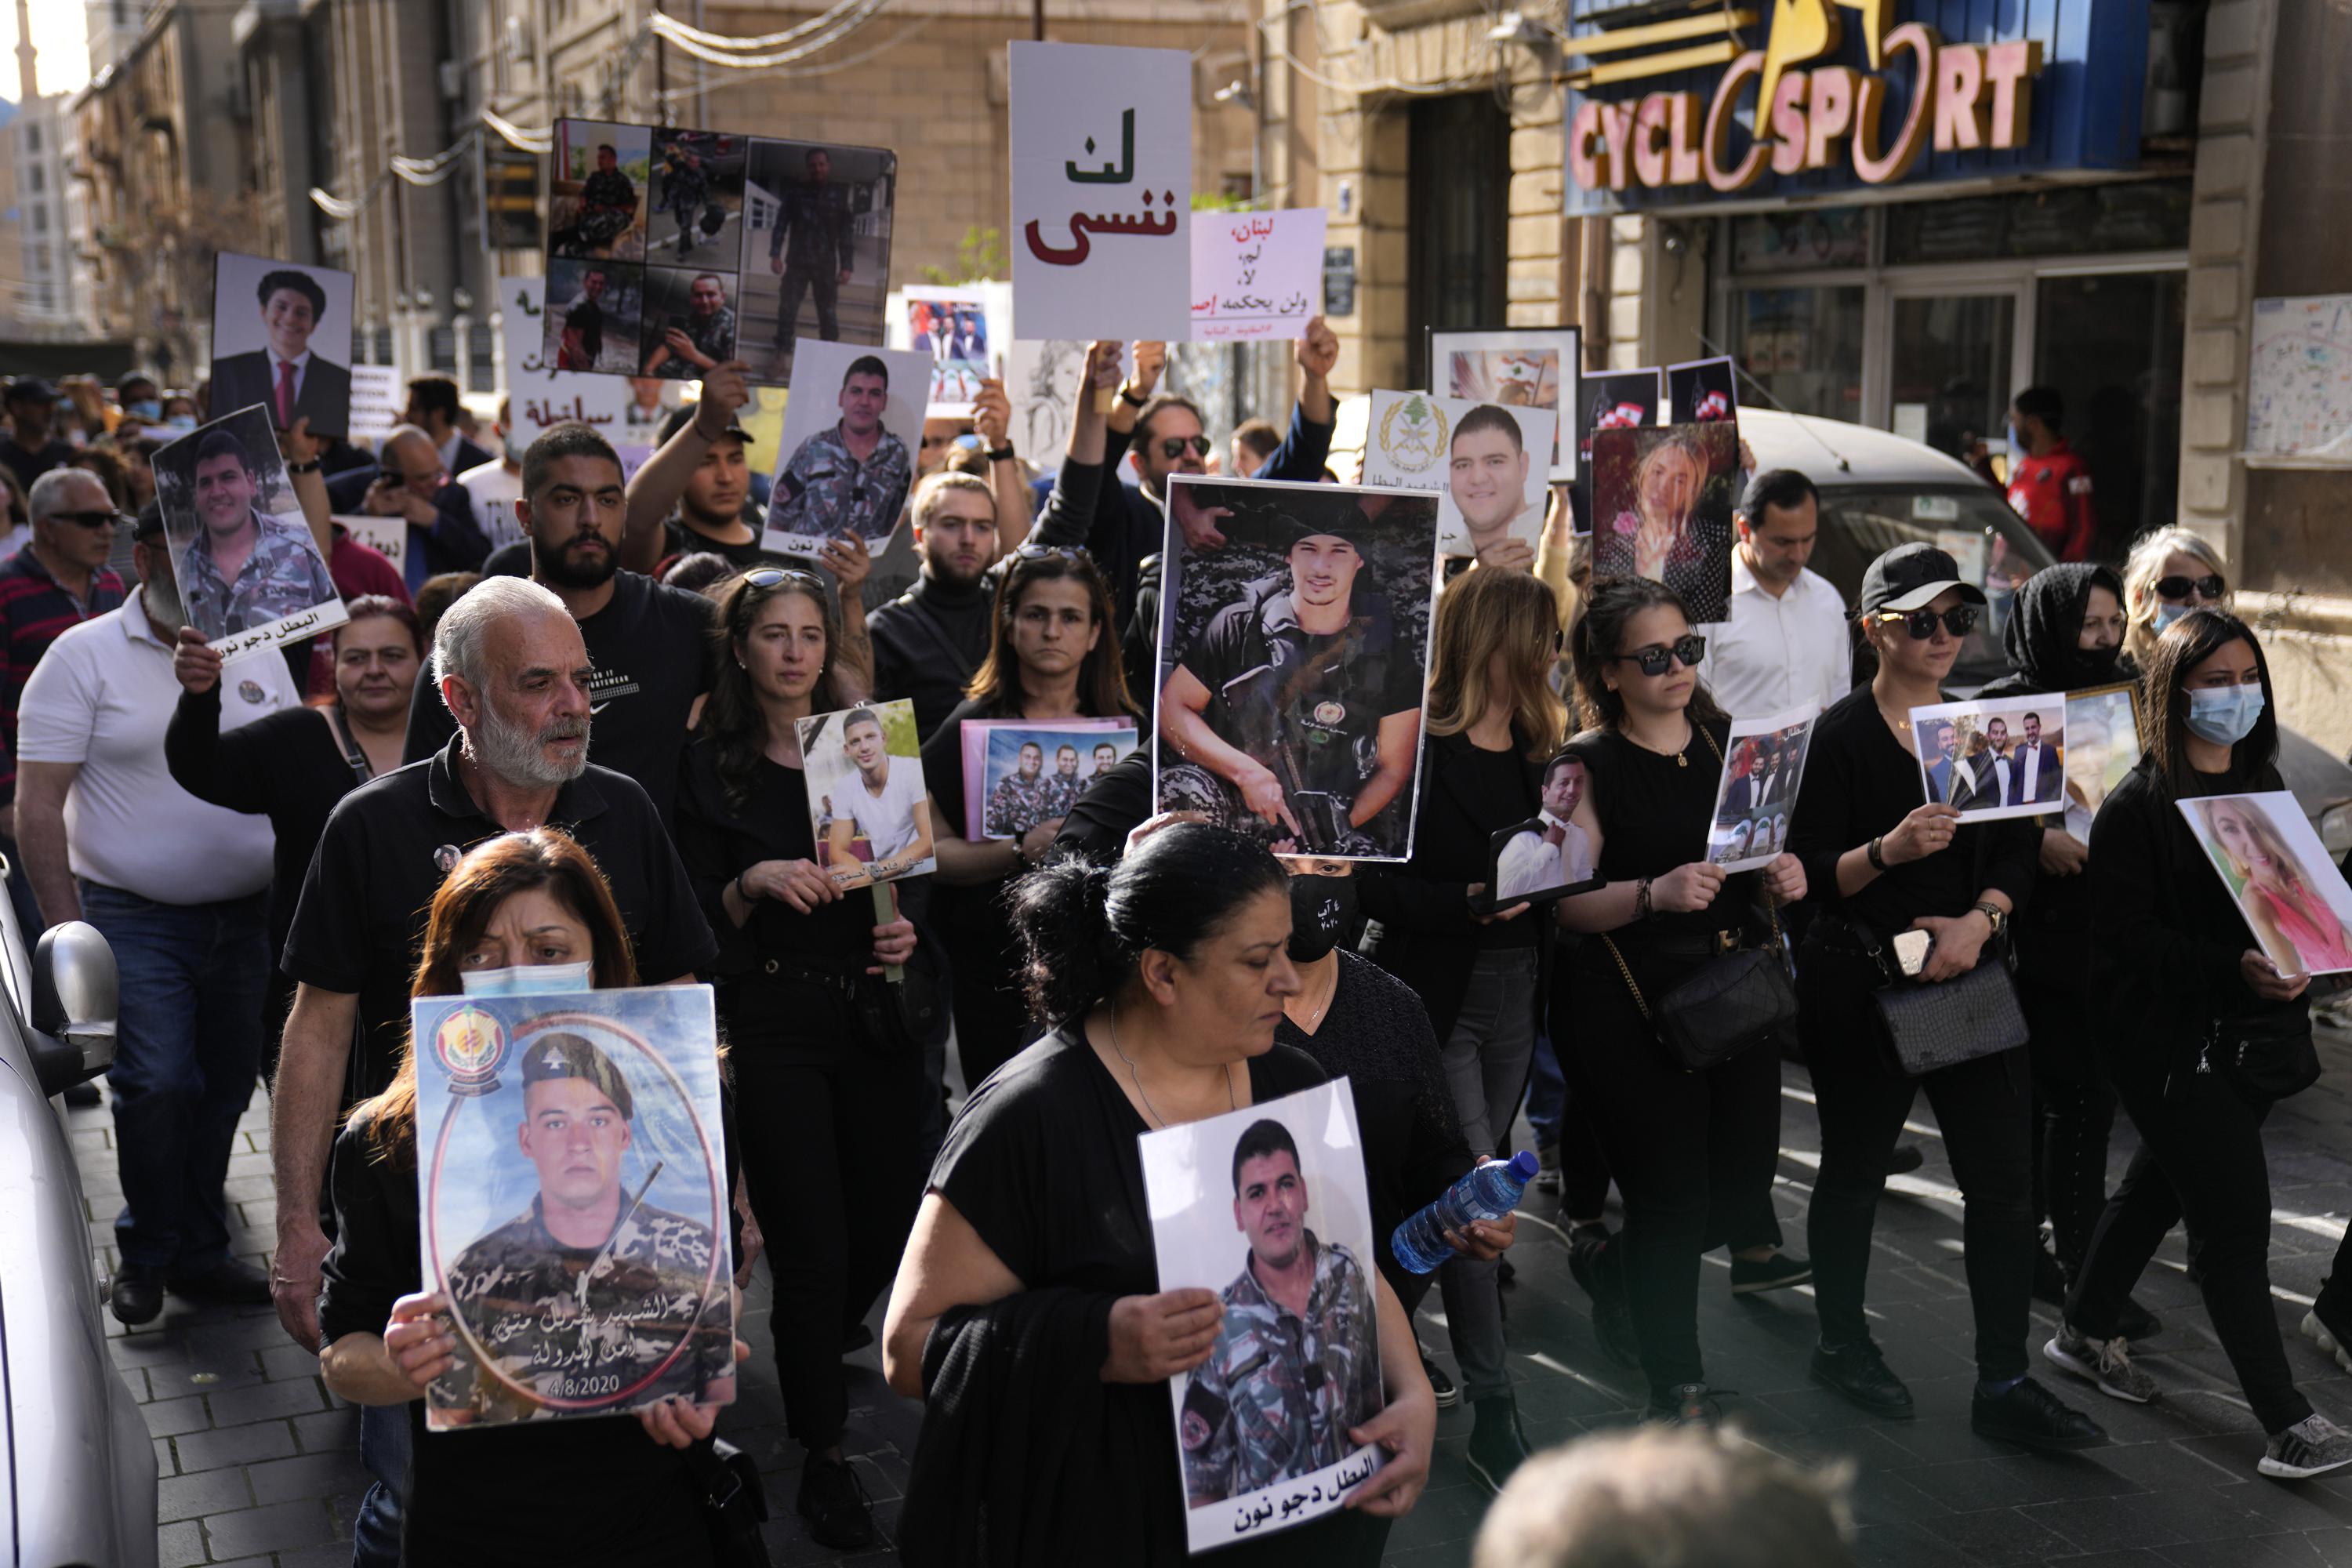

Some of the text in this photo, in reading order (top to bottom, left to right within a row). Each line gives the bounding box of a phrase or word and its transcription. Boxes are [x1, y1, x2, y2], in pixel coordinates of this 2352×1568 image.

[1570, 22, 2028, 192] CYCLOSPORT
[1065, 107, 1134, 184] لن
[1025, 188, 1178, 267] ننسى
[788, 539, 813, 554] نون
[276, 612, 320, 639] البطل
[590, 675, 628, 688] ORTSWEAR
[598, 1293, 669, 1329] الشهيد
[550, 1374, 619, 1398] 4/8/2020
[1235, 1495, 1272, 1533] نون
[1279, 1484, 1321, 1519] دجو
